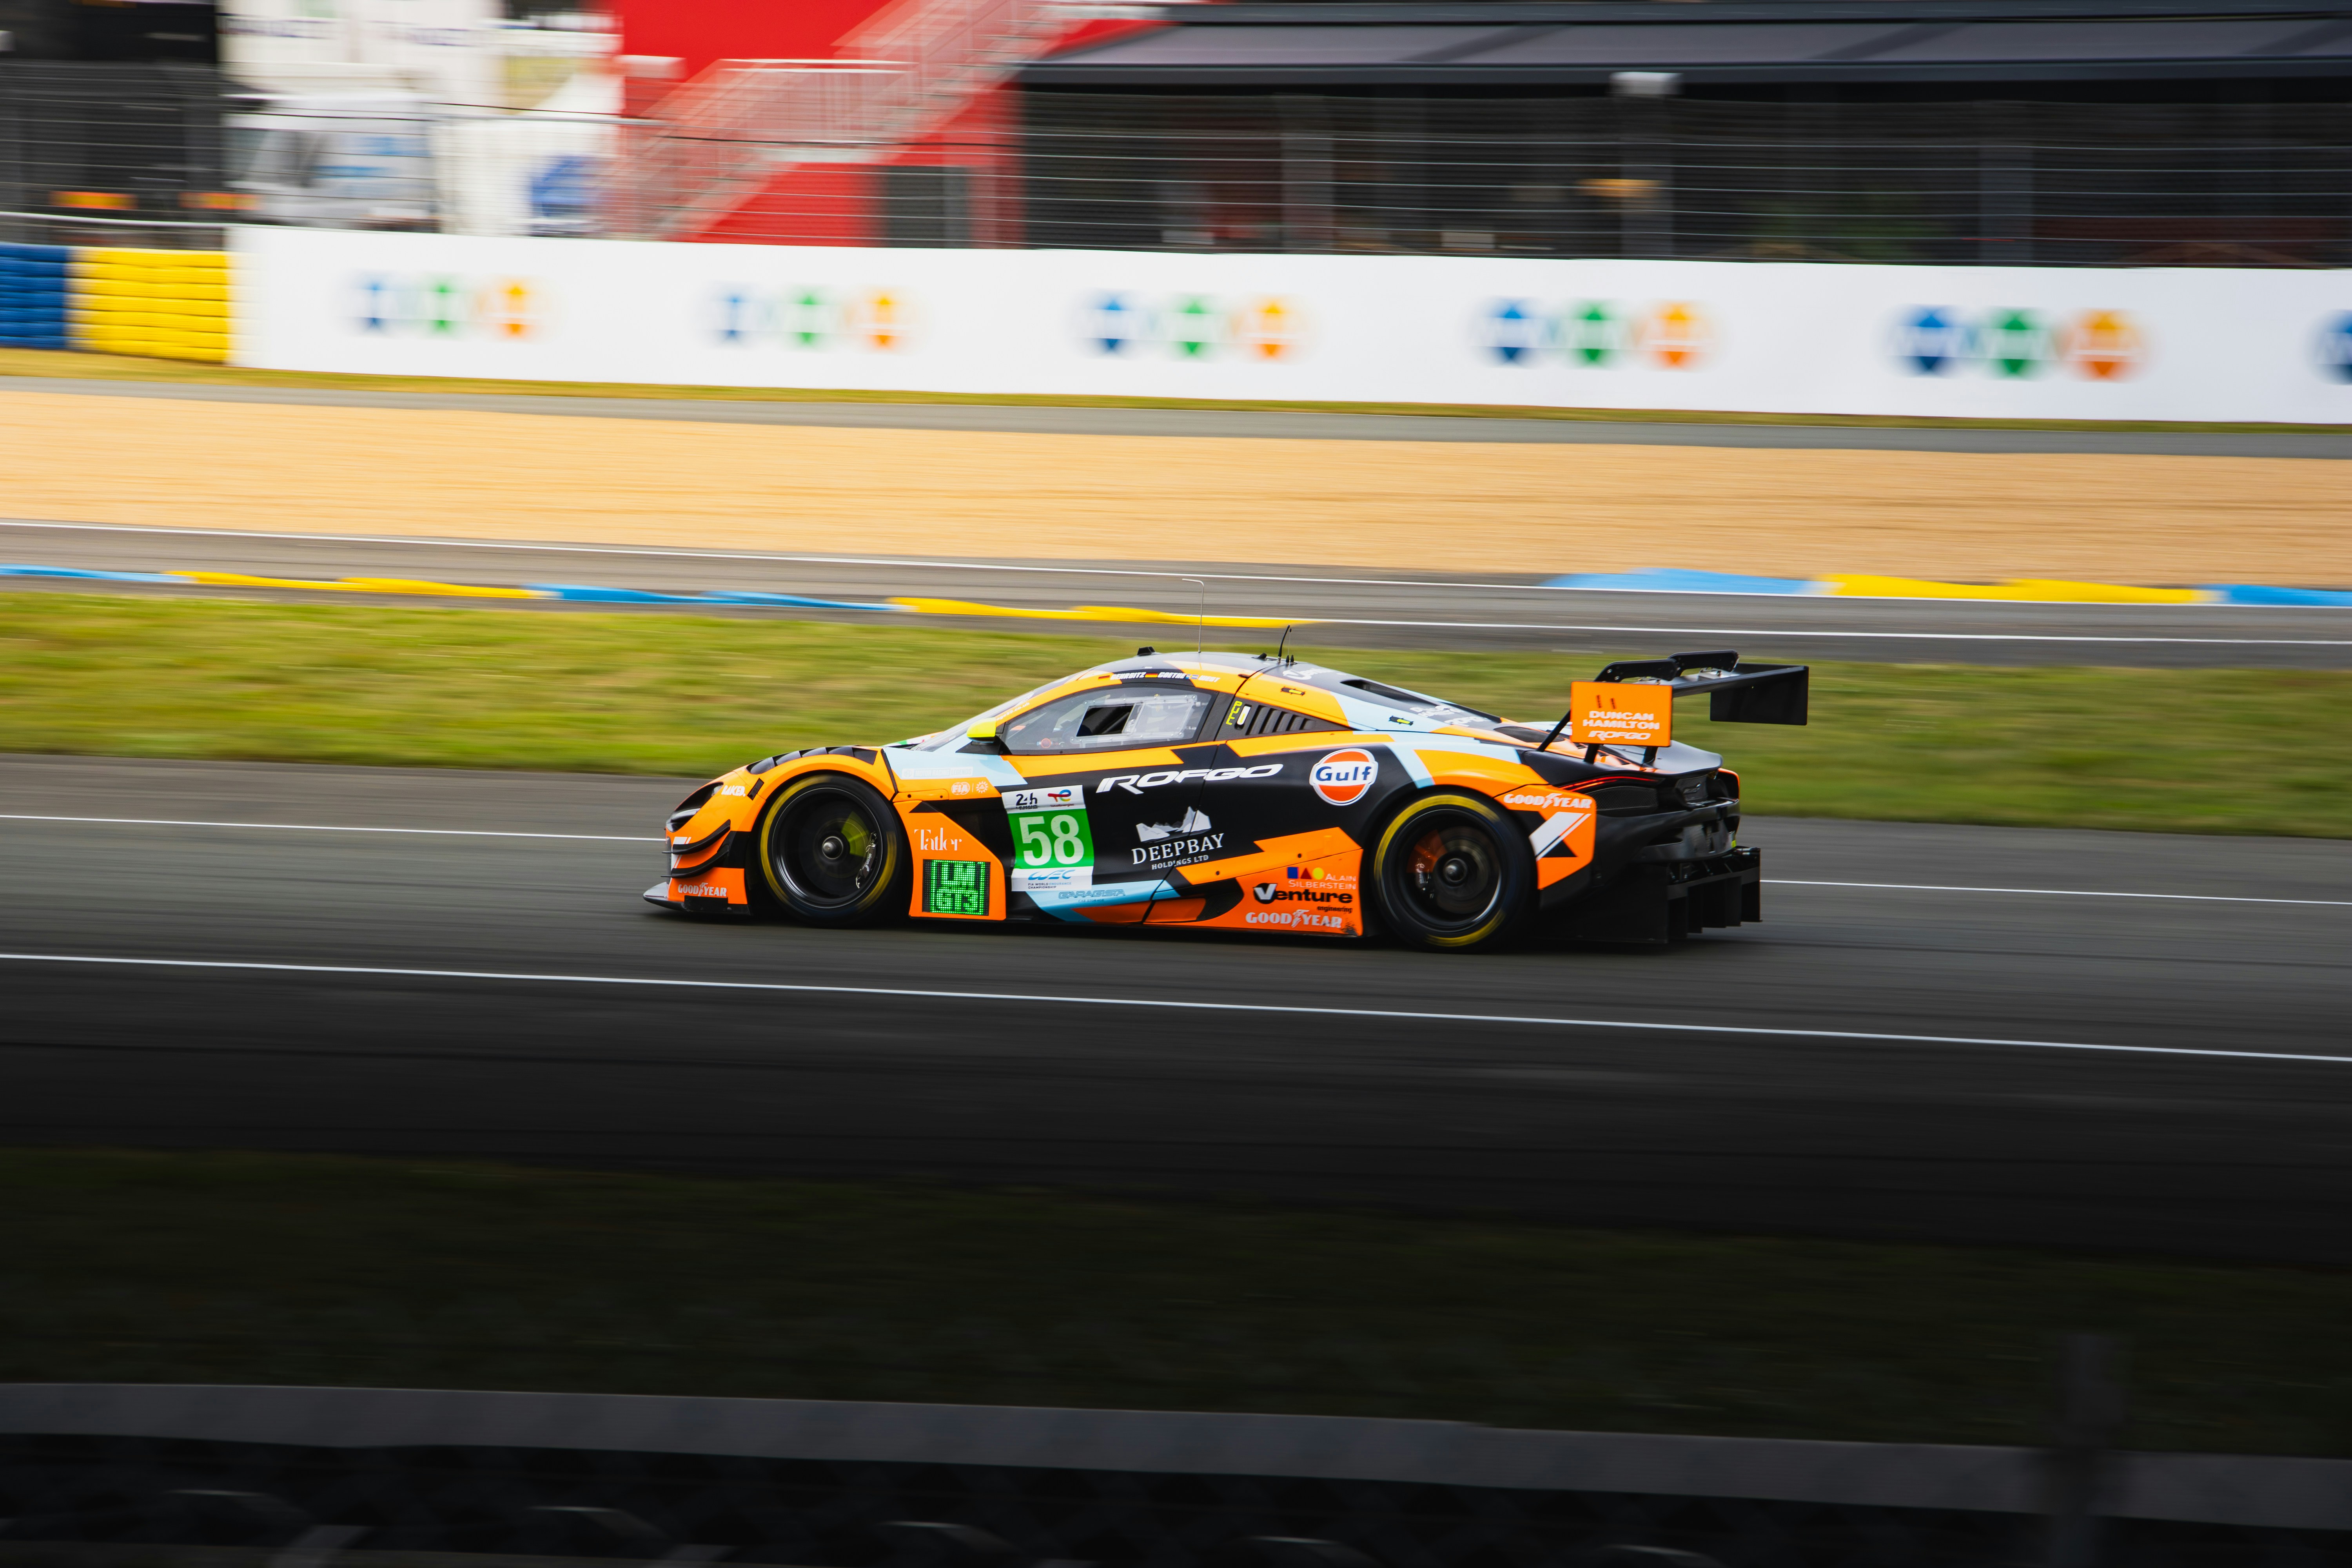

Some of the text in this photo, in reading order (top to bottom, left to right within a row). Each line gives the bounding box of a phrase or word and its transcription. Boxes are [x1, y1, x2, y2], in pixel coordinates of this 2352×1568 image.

[1589, 711, 1654, 720] DUNCAN
[1583, 719, 1660, 730] HAMILTON
[1588, 731, 1651, 740] ROFGO
[1096, 764, 1283, 794] ROFGO
[1316, 766, 1372, 781] Gulf
[914, 828, 962, 851] Tatler
[1019, 815, 1084, 866] 58
[1131, 833, 1224, 864] DEEPBAY
[1152, 855, 1209, 870] HOLDINGS LTD
[1028, 869, 1076, 880] WEC
[1288, 880, 1356, 889] SILBERSTEIN
[936, 888, 978, 912] GT3
[1058, 889, 1126, 899] GARAGISTA
[1253, 883, 1353, 904] Venture
[1317, 906, 1353, 914] engineering
